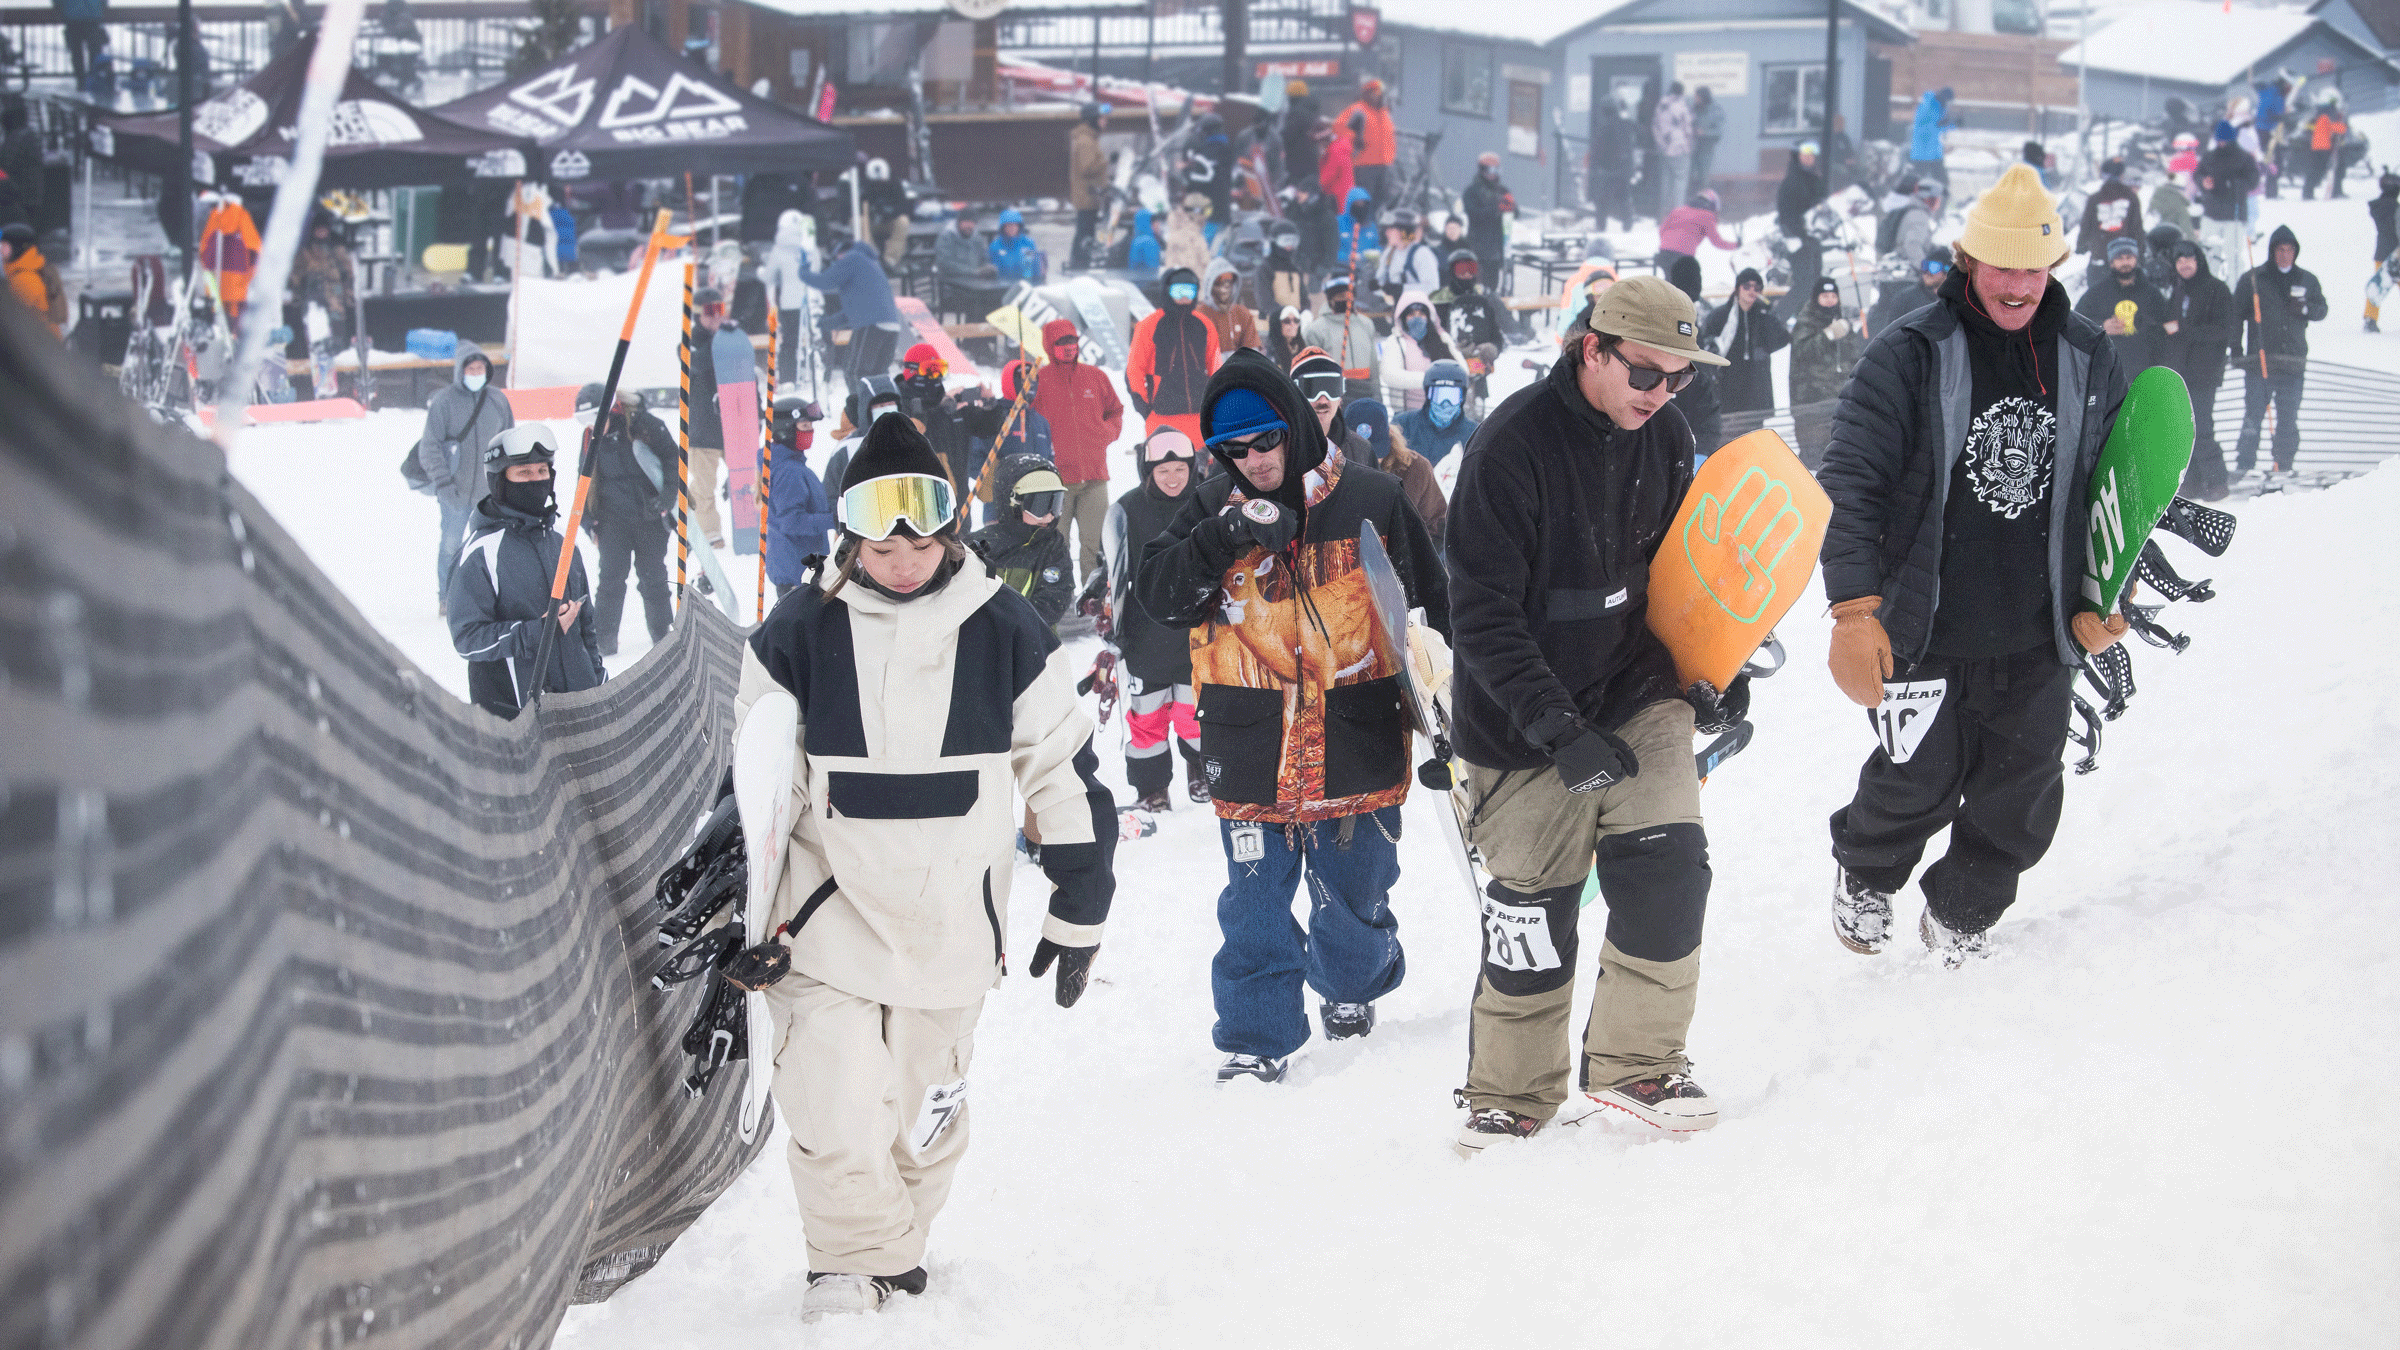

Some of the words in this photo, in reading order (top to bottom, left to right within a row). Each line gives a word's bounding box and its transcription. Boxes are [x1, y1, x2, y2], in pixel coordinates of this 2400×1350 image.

[665, 115, 748, 139] BEAR
[1895, 689, 1942, 700] BEAR
[1497, 911, 1541, 924] BEAR
